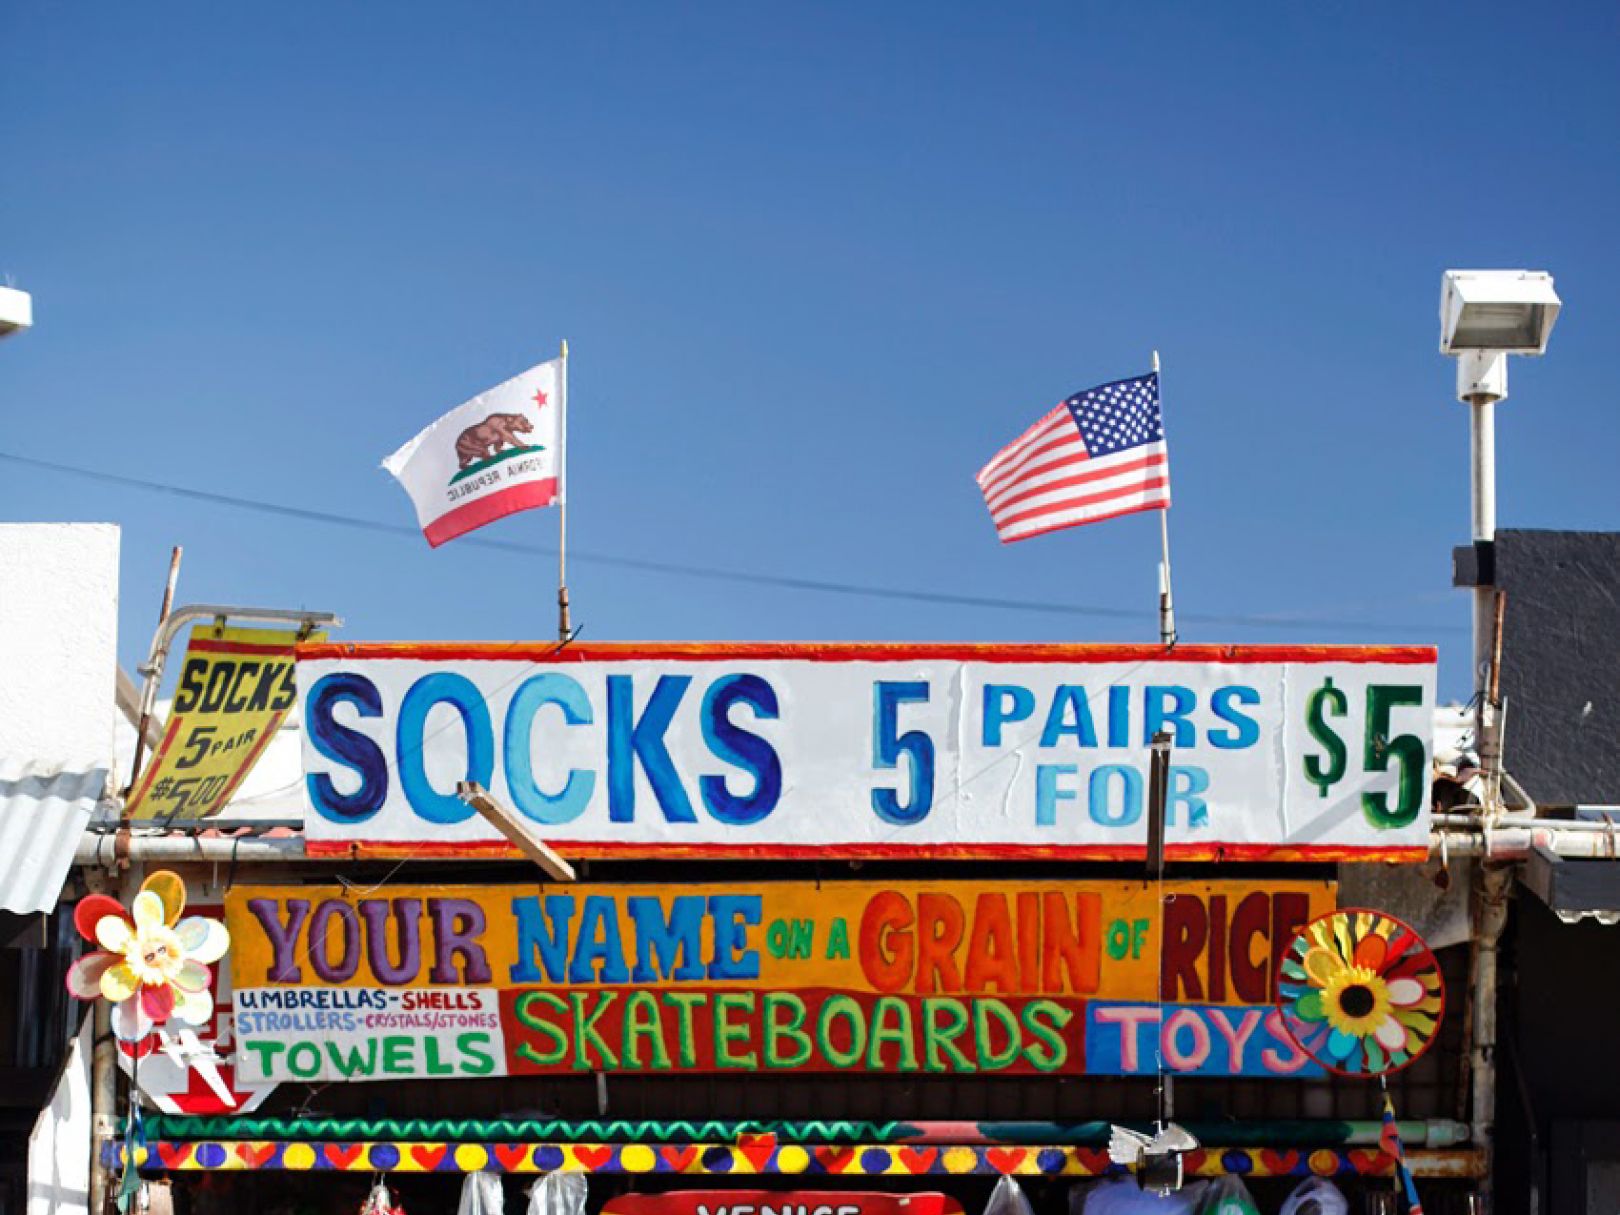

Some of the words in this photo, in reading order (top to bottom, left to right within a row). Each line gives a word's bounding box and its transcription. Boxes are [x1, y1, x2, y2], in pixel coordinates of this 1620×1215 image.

[175, 658, 297, 713] SOCKS
[175, 726, 218, 768] 5
[212, 728, 257, 756] PAIR
[305, 671, 783, 827] SOCKS
[871, 679, 936, 826] 5
[981, 683, 1261, 749] PAIRS
[1302, 675, 1425, 829] $5
[1034, 763, 1210, 828] FOR
[247, 897, 494, 987] YOUR
[509, 894, 763, 985] NAME
[765, 917, 815, 960] ON
[825, 916, 851, 960] A
[858, 889, 1101, 994] GRAIN
[1106, 917, 1151, 960] OF
[245, 1031, 496, 1078] TOWELS
[515, 990, 1074, 1073] SKATEBOARDS
[1094, 1005, 1328, 1075] TOYS
